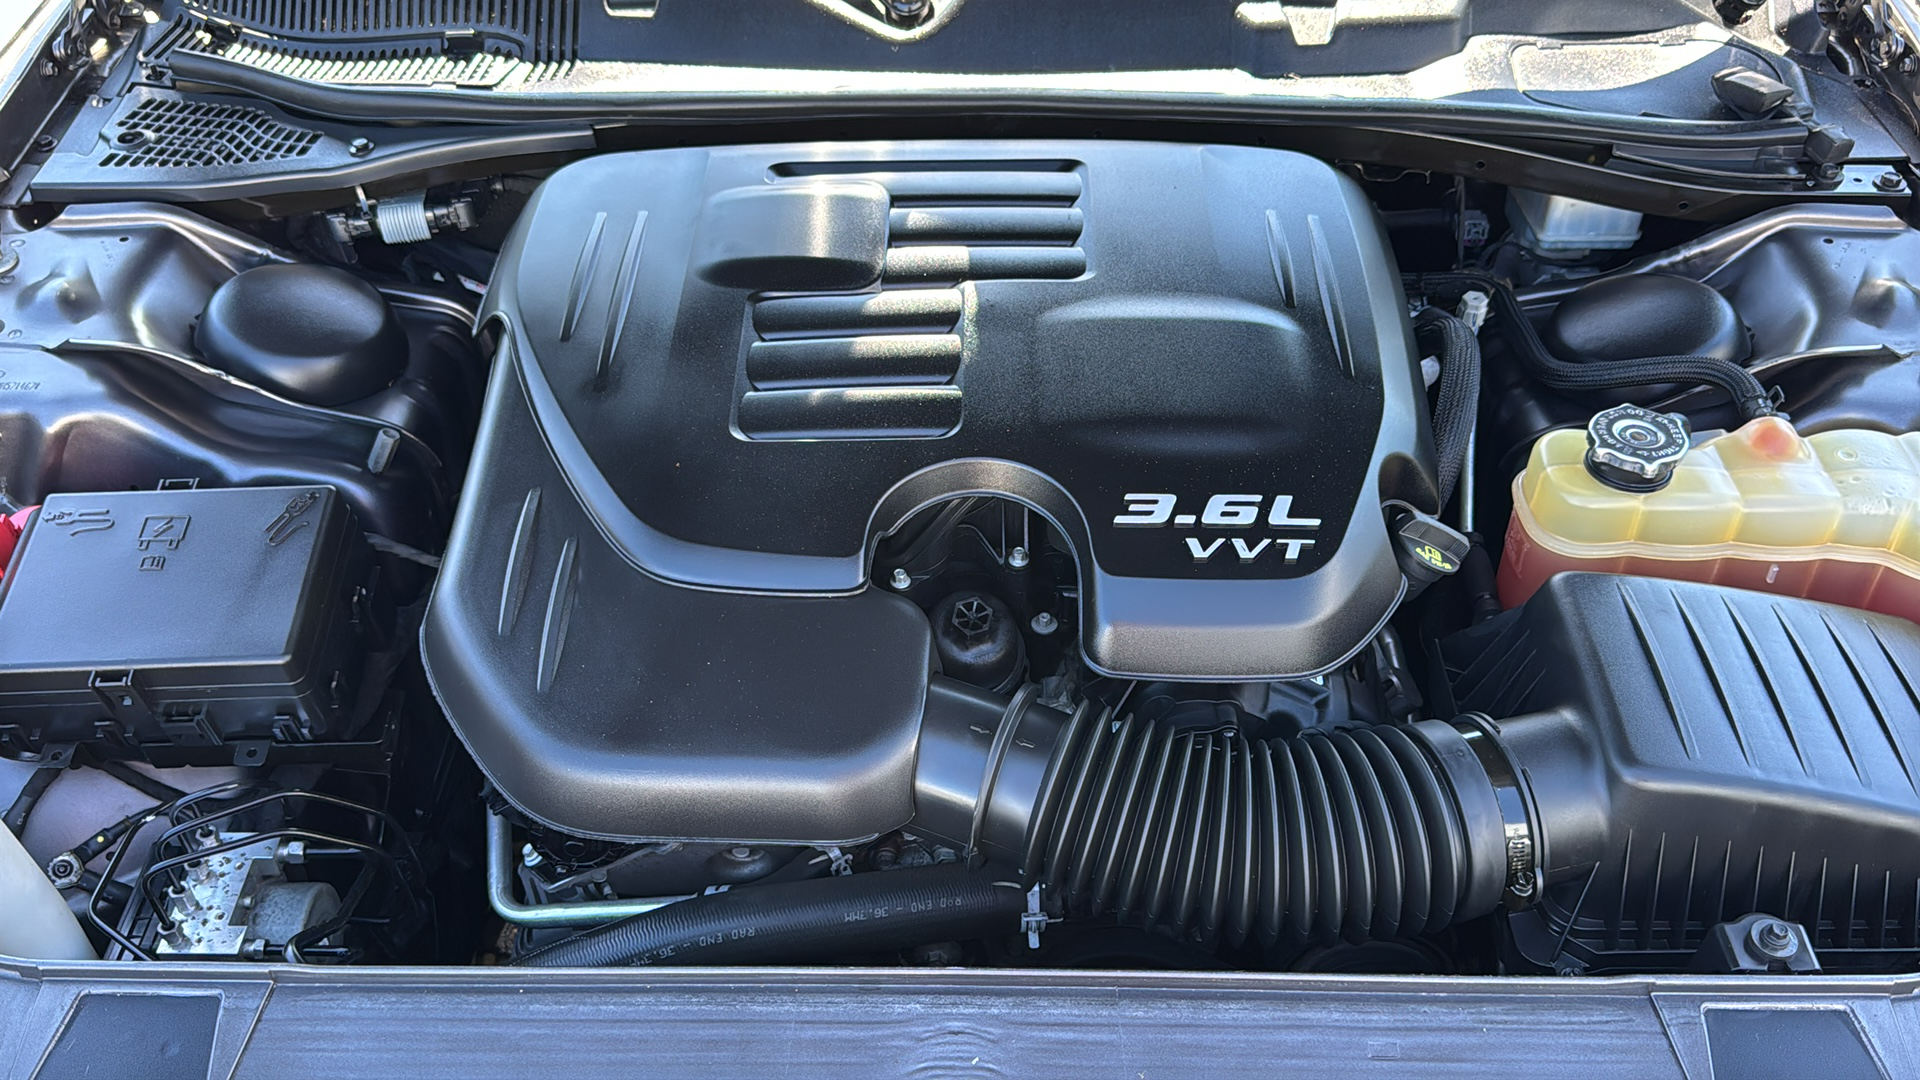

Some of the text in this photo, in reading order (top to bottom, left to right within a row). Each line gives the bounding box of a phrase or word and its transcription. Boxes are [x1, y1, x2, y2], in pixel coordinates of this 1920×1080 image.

[1113, 493, 1322, 528] 3.6L
[1185, 537, 1316, 563] VVT
[911, 900, 932, 913] END
[699, 932, 723, 947] END
[731, 926, 755, 940] RAD
